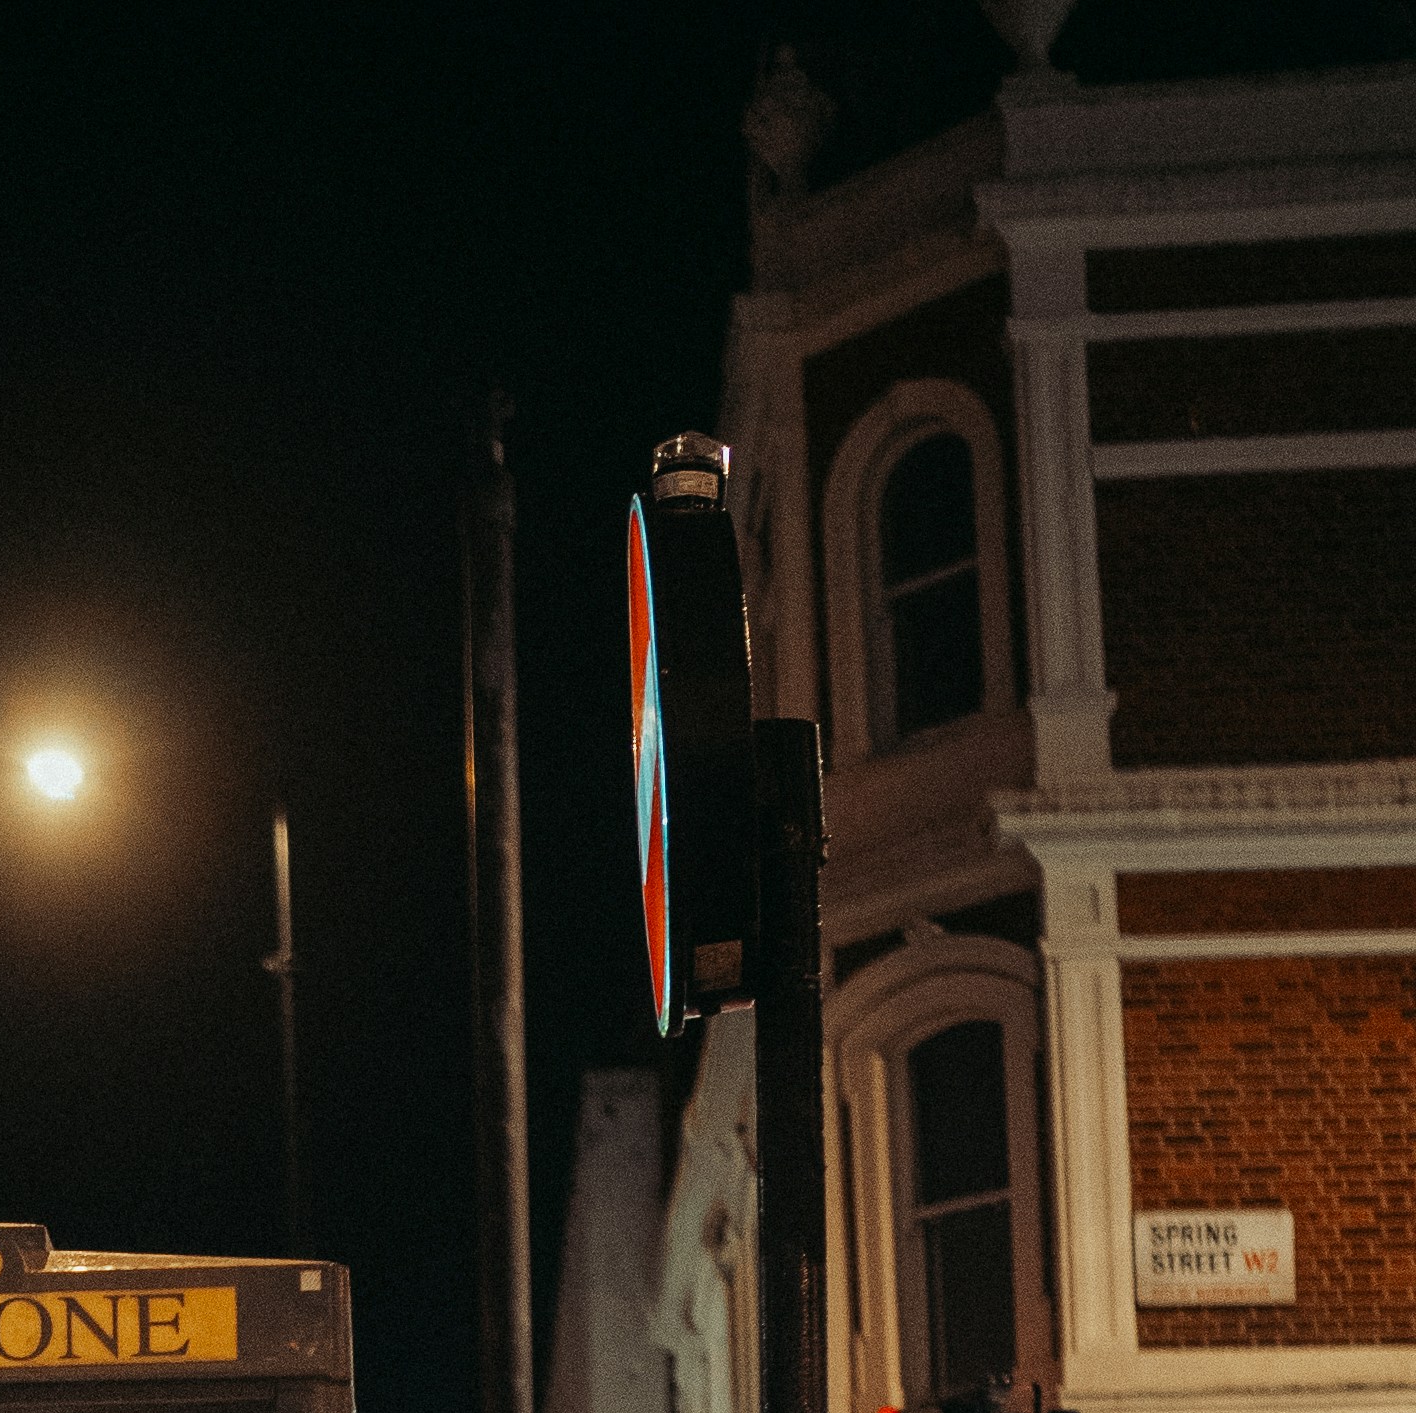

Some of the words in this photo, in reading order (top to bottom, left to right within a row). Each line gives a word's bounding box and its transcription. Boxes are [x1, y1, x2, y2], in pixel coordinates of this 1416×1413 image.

[1150, 1222, 1238, 1246] SPRING
[1151, 1250, 1234, 1274] STREET
[1242, 1248, 1279, 1273] W2
